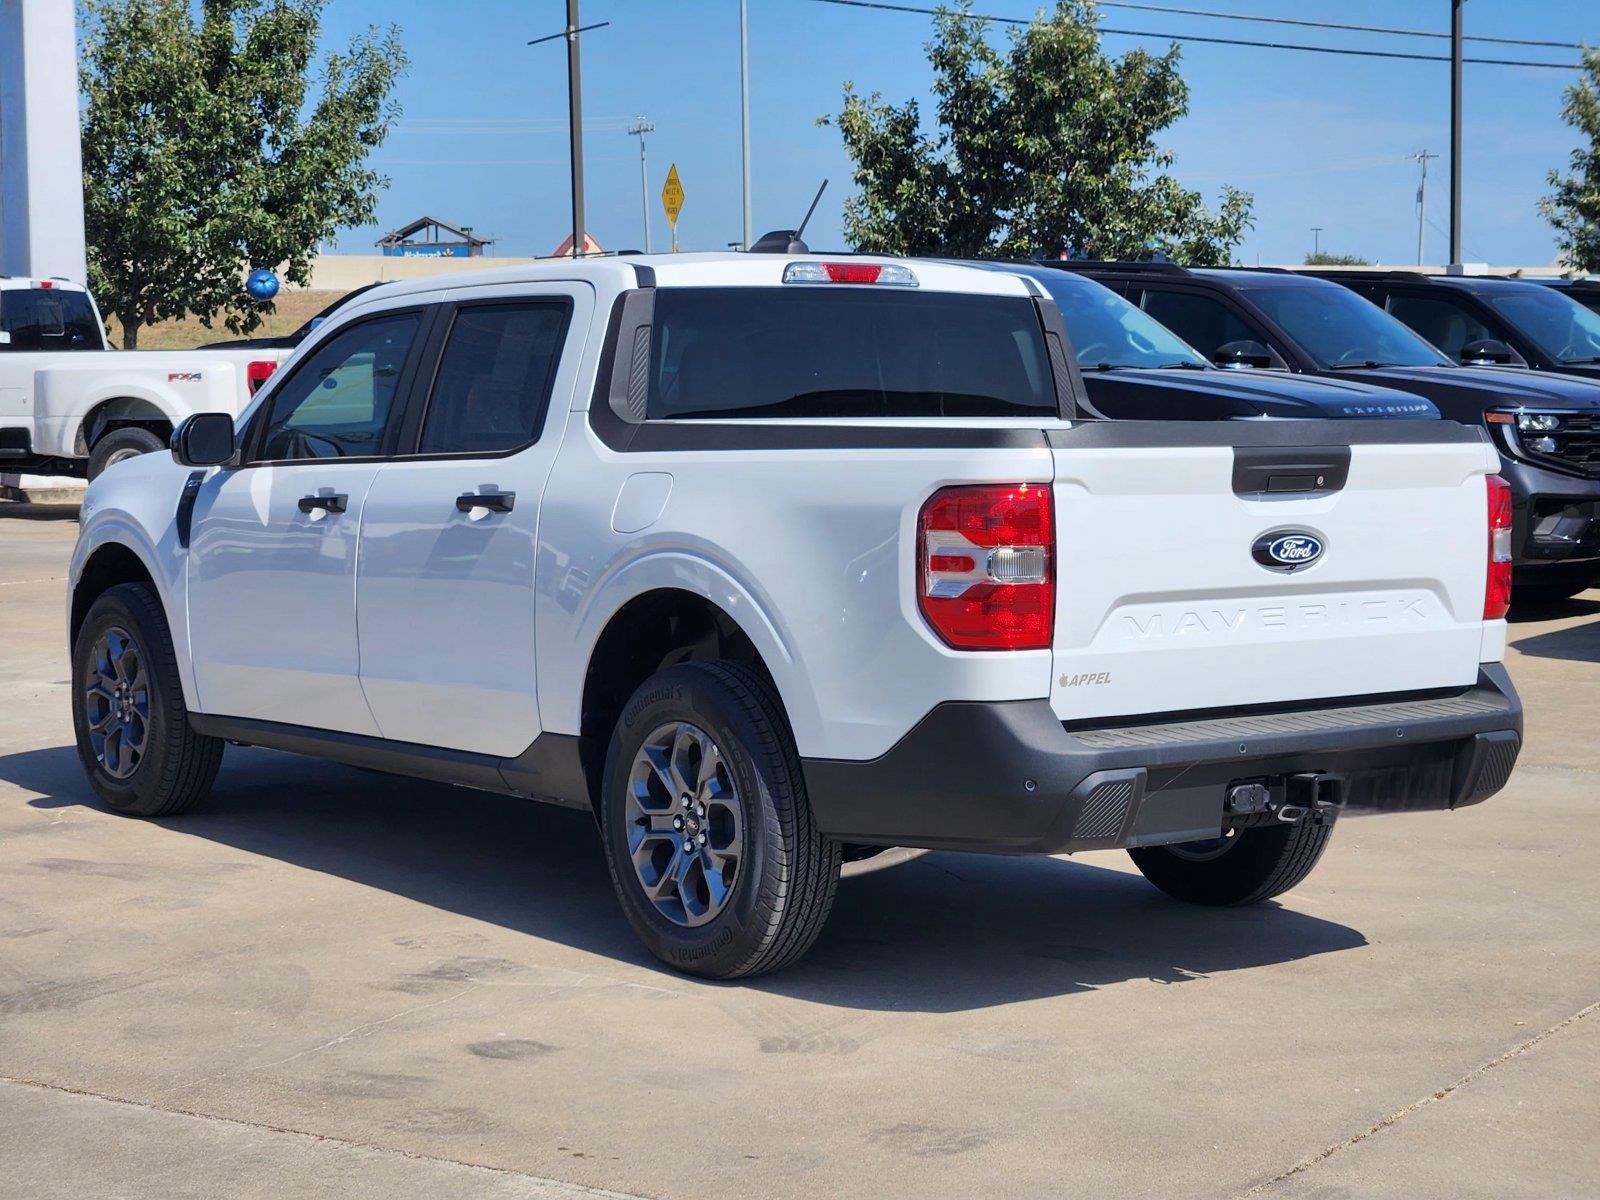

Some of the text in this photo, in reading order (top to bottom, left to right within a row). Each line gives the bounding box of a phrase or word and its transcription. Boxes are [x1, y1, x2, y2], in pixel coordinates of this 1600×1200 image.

[168, 372, 202, 383] FX4
[1280, 539, 1313, 558] Ford
[1122, 598, 1427, 638] MAVERICK
[1068, 672, 1112, 687] APPEL
[625, 684, 674, 728] Continental
[678, 926, 733, 962] Continental
